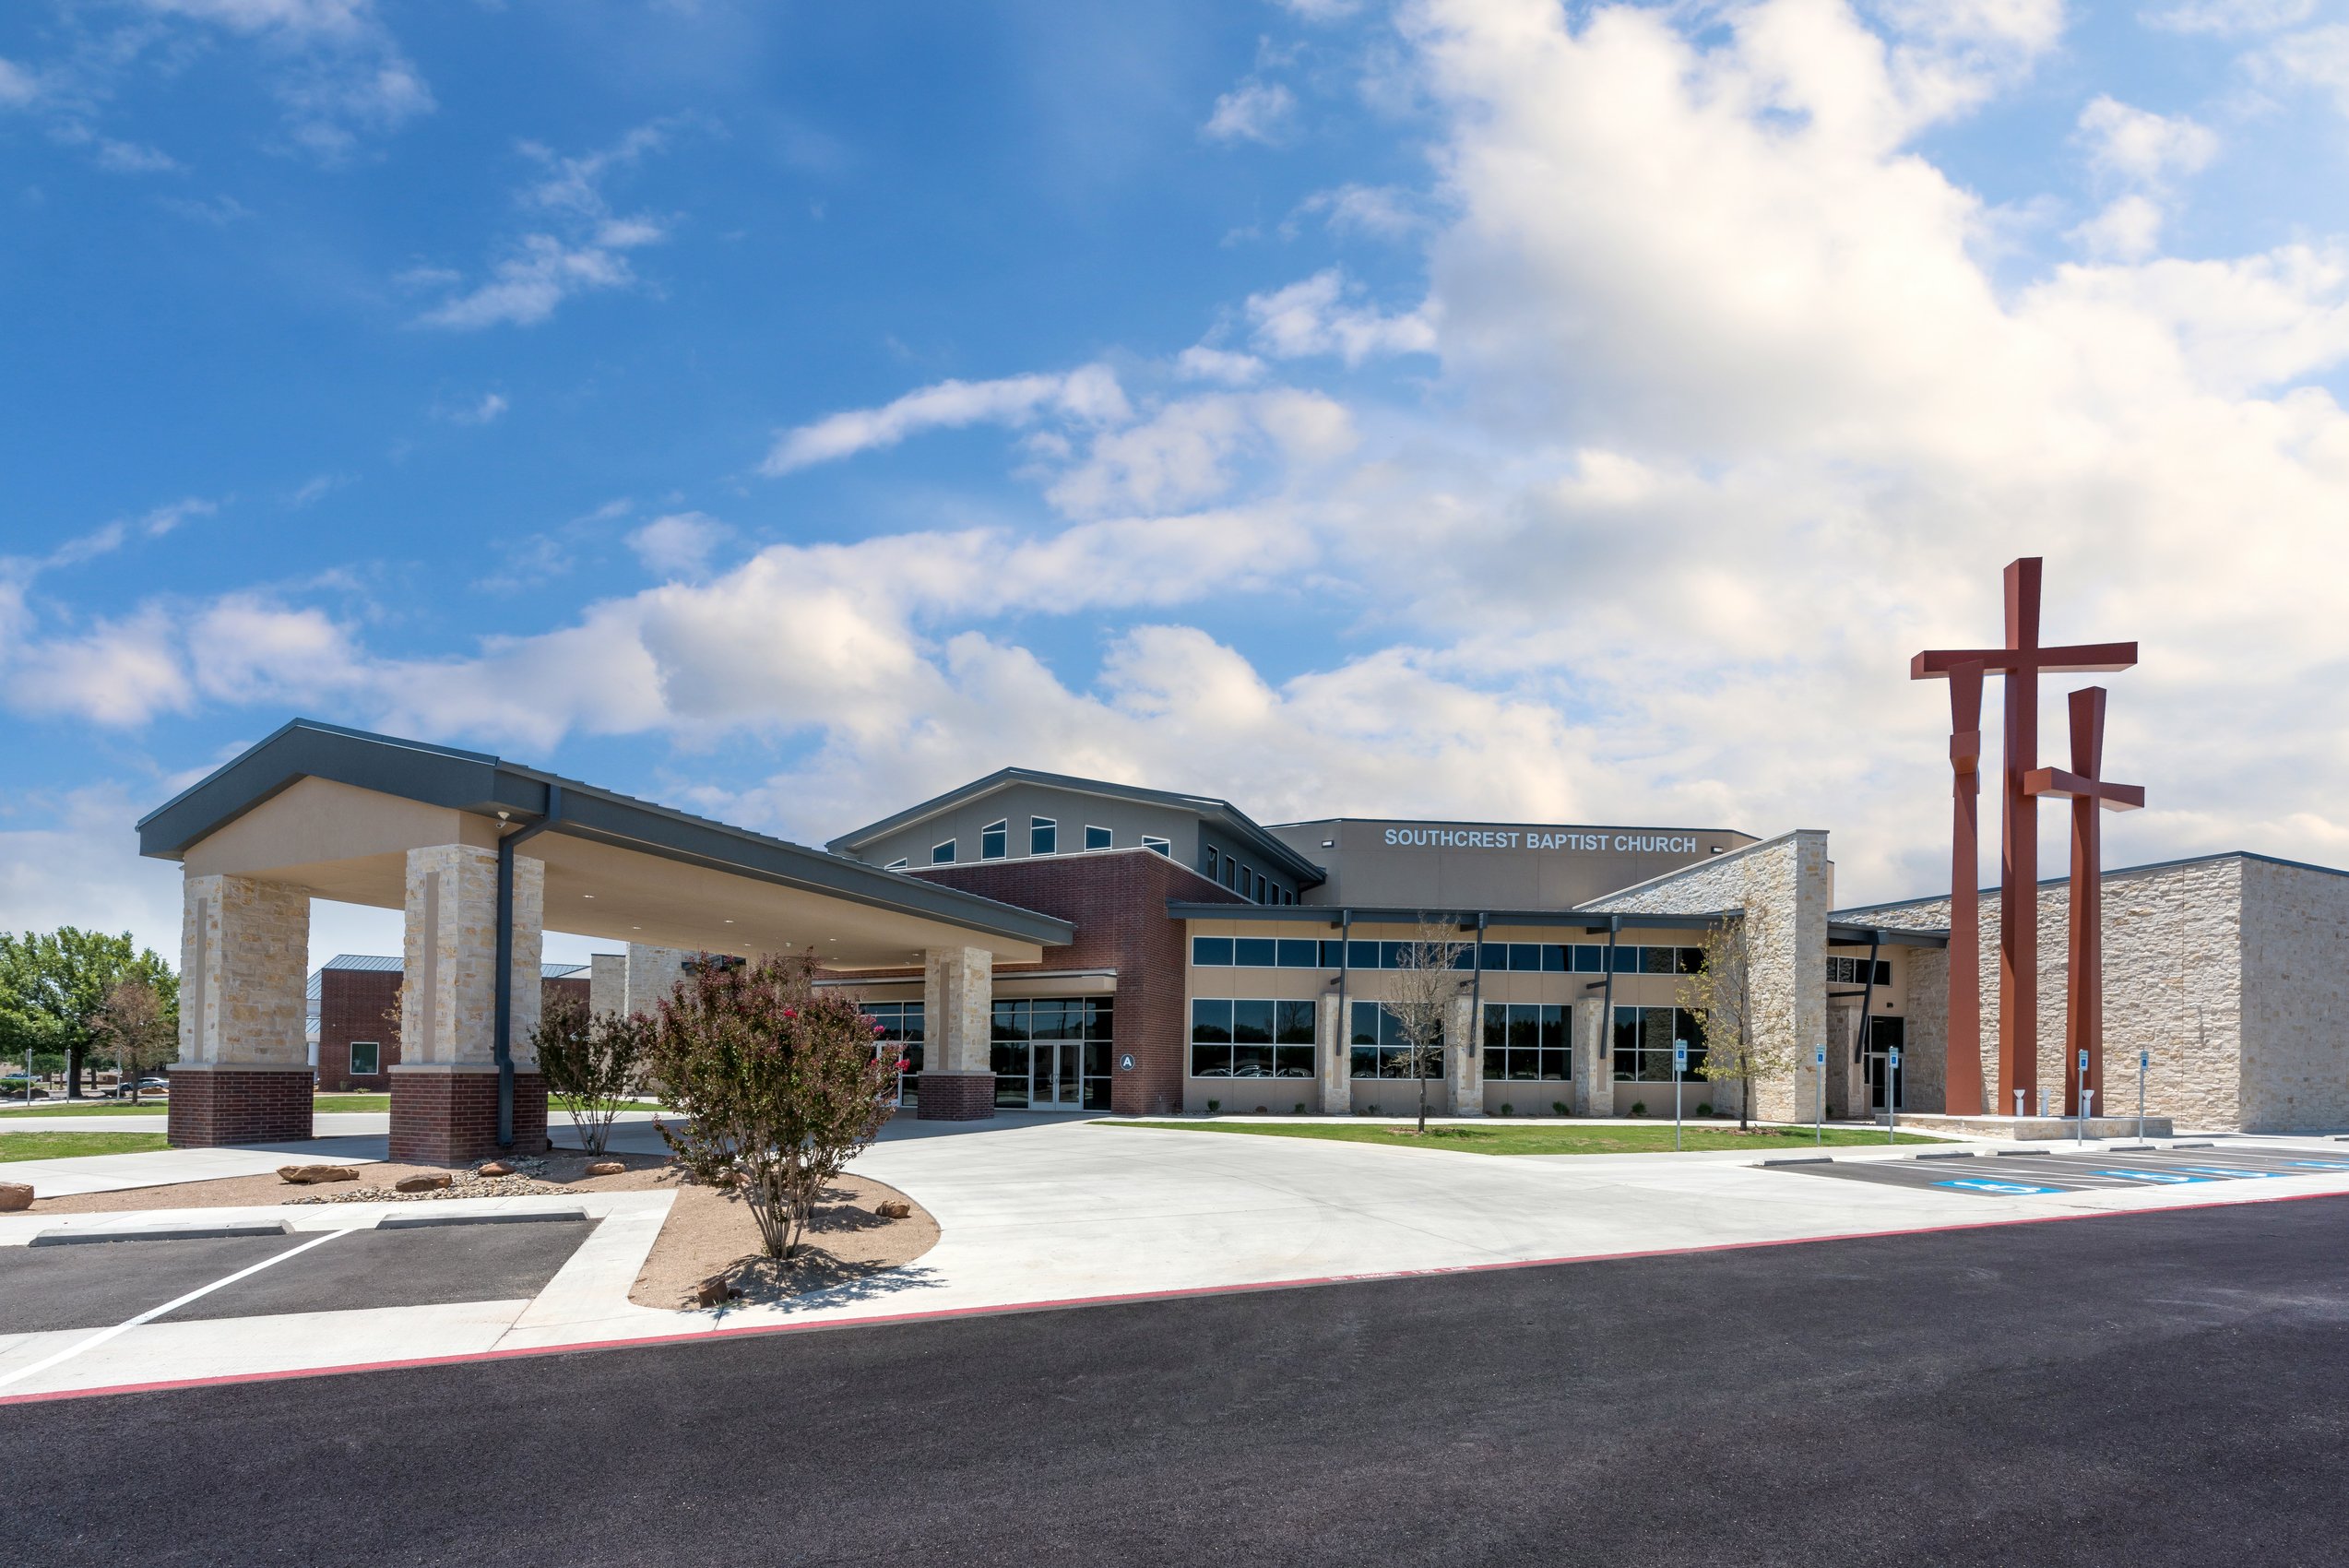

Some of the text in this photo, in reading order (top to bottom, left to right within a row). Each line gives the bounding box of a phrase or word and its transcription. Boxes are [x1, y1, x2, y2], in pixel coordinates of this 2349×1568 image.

[1384, 828, 1697, 853] SOUTHCREST BAPTIST CHURCH
[1122, 1056, 1133, 1067] A
